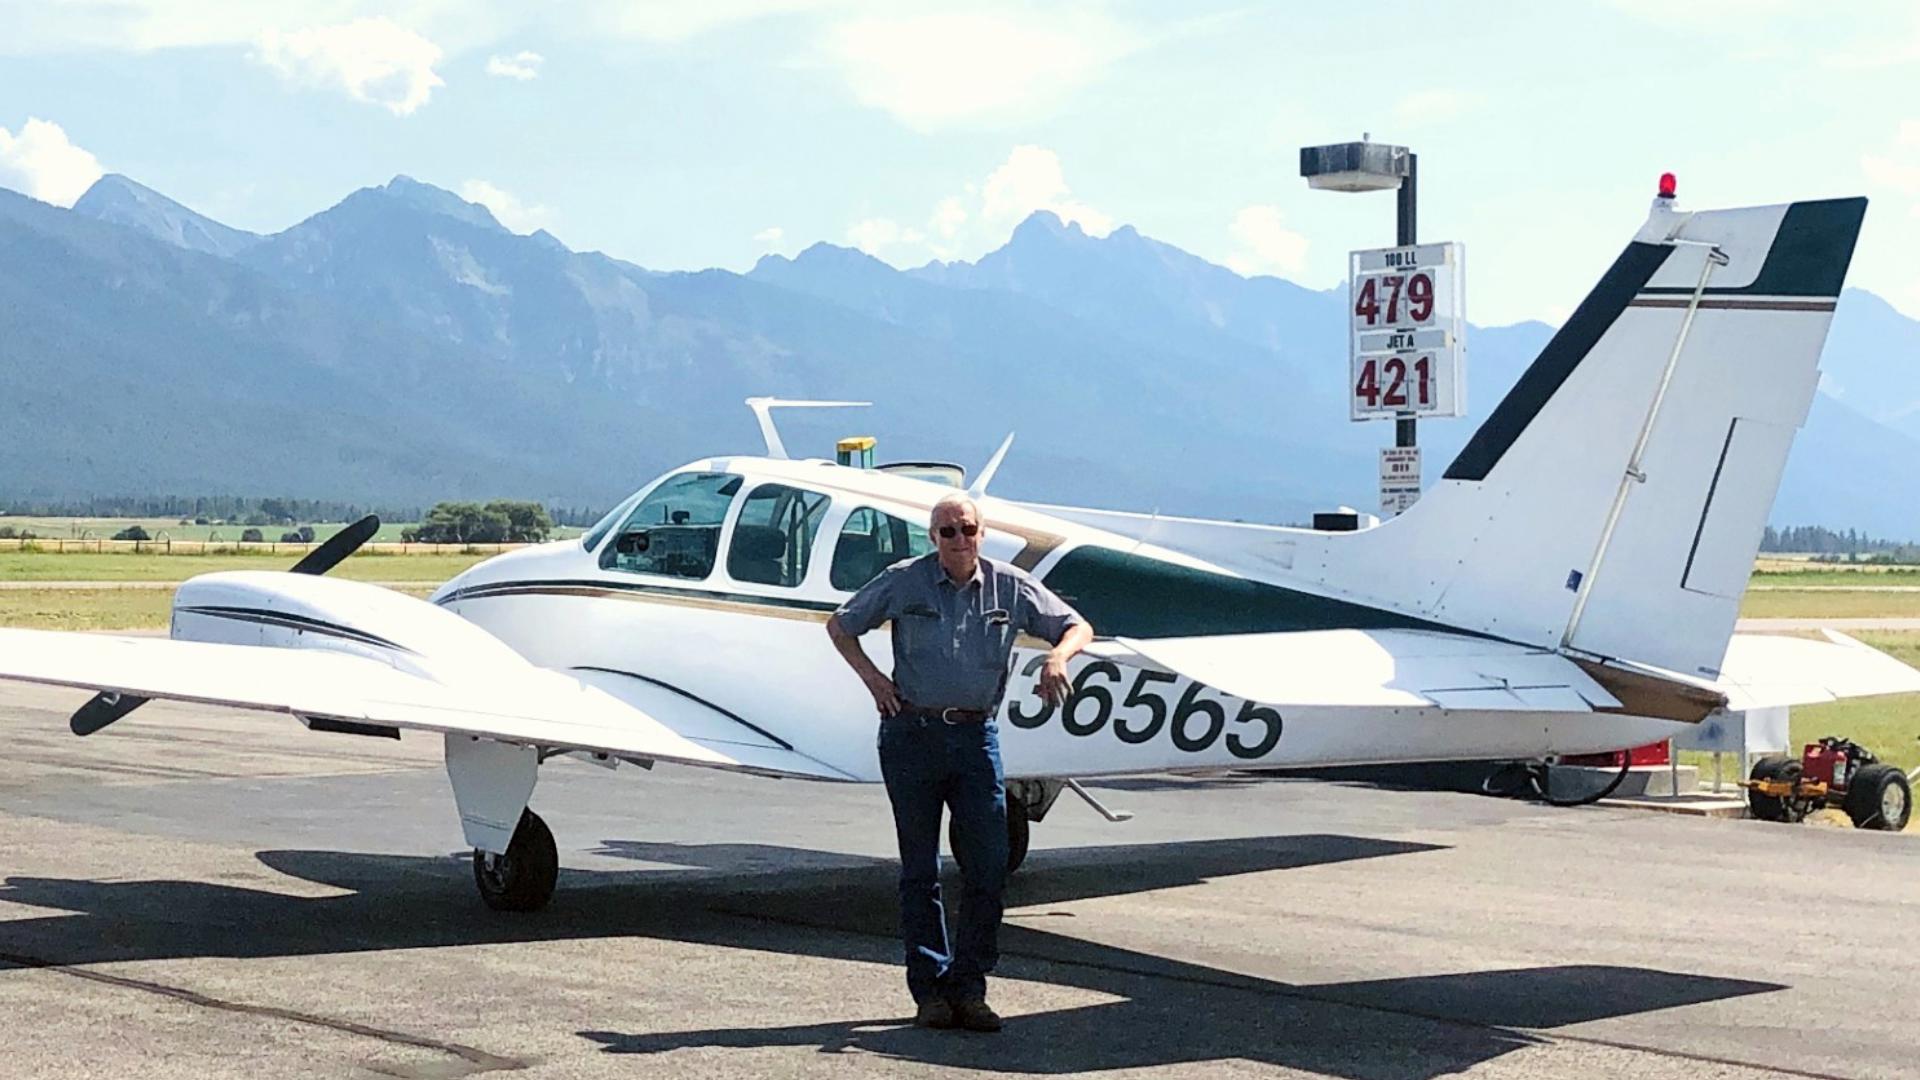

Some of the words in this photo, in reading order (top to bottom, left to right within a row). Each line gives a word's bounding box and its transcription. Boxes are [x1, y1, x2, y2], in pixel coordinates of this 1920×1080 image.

[1385, 251, 1402, 267] 100
[1404, 251, 1417, 265] LL
[1355, 273, 1434, 325] 479
[1386, 335, 1405, 349] JET
[1407, 334, 1415, 348] A
[1355, 356, 1430, 407] 421
[1008, 651, 1283, 760] 36565
